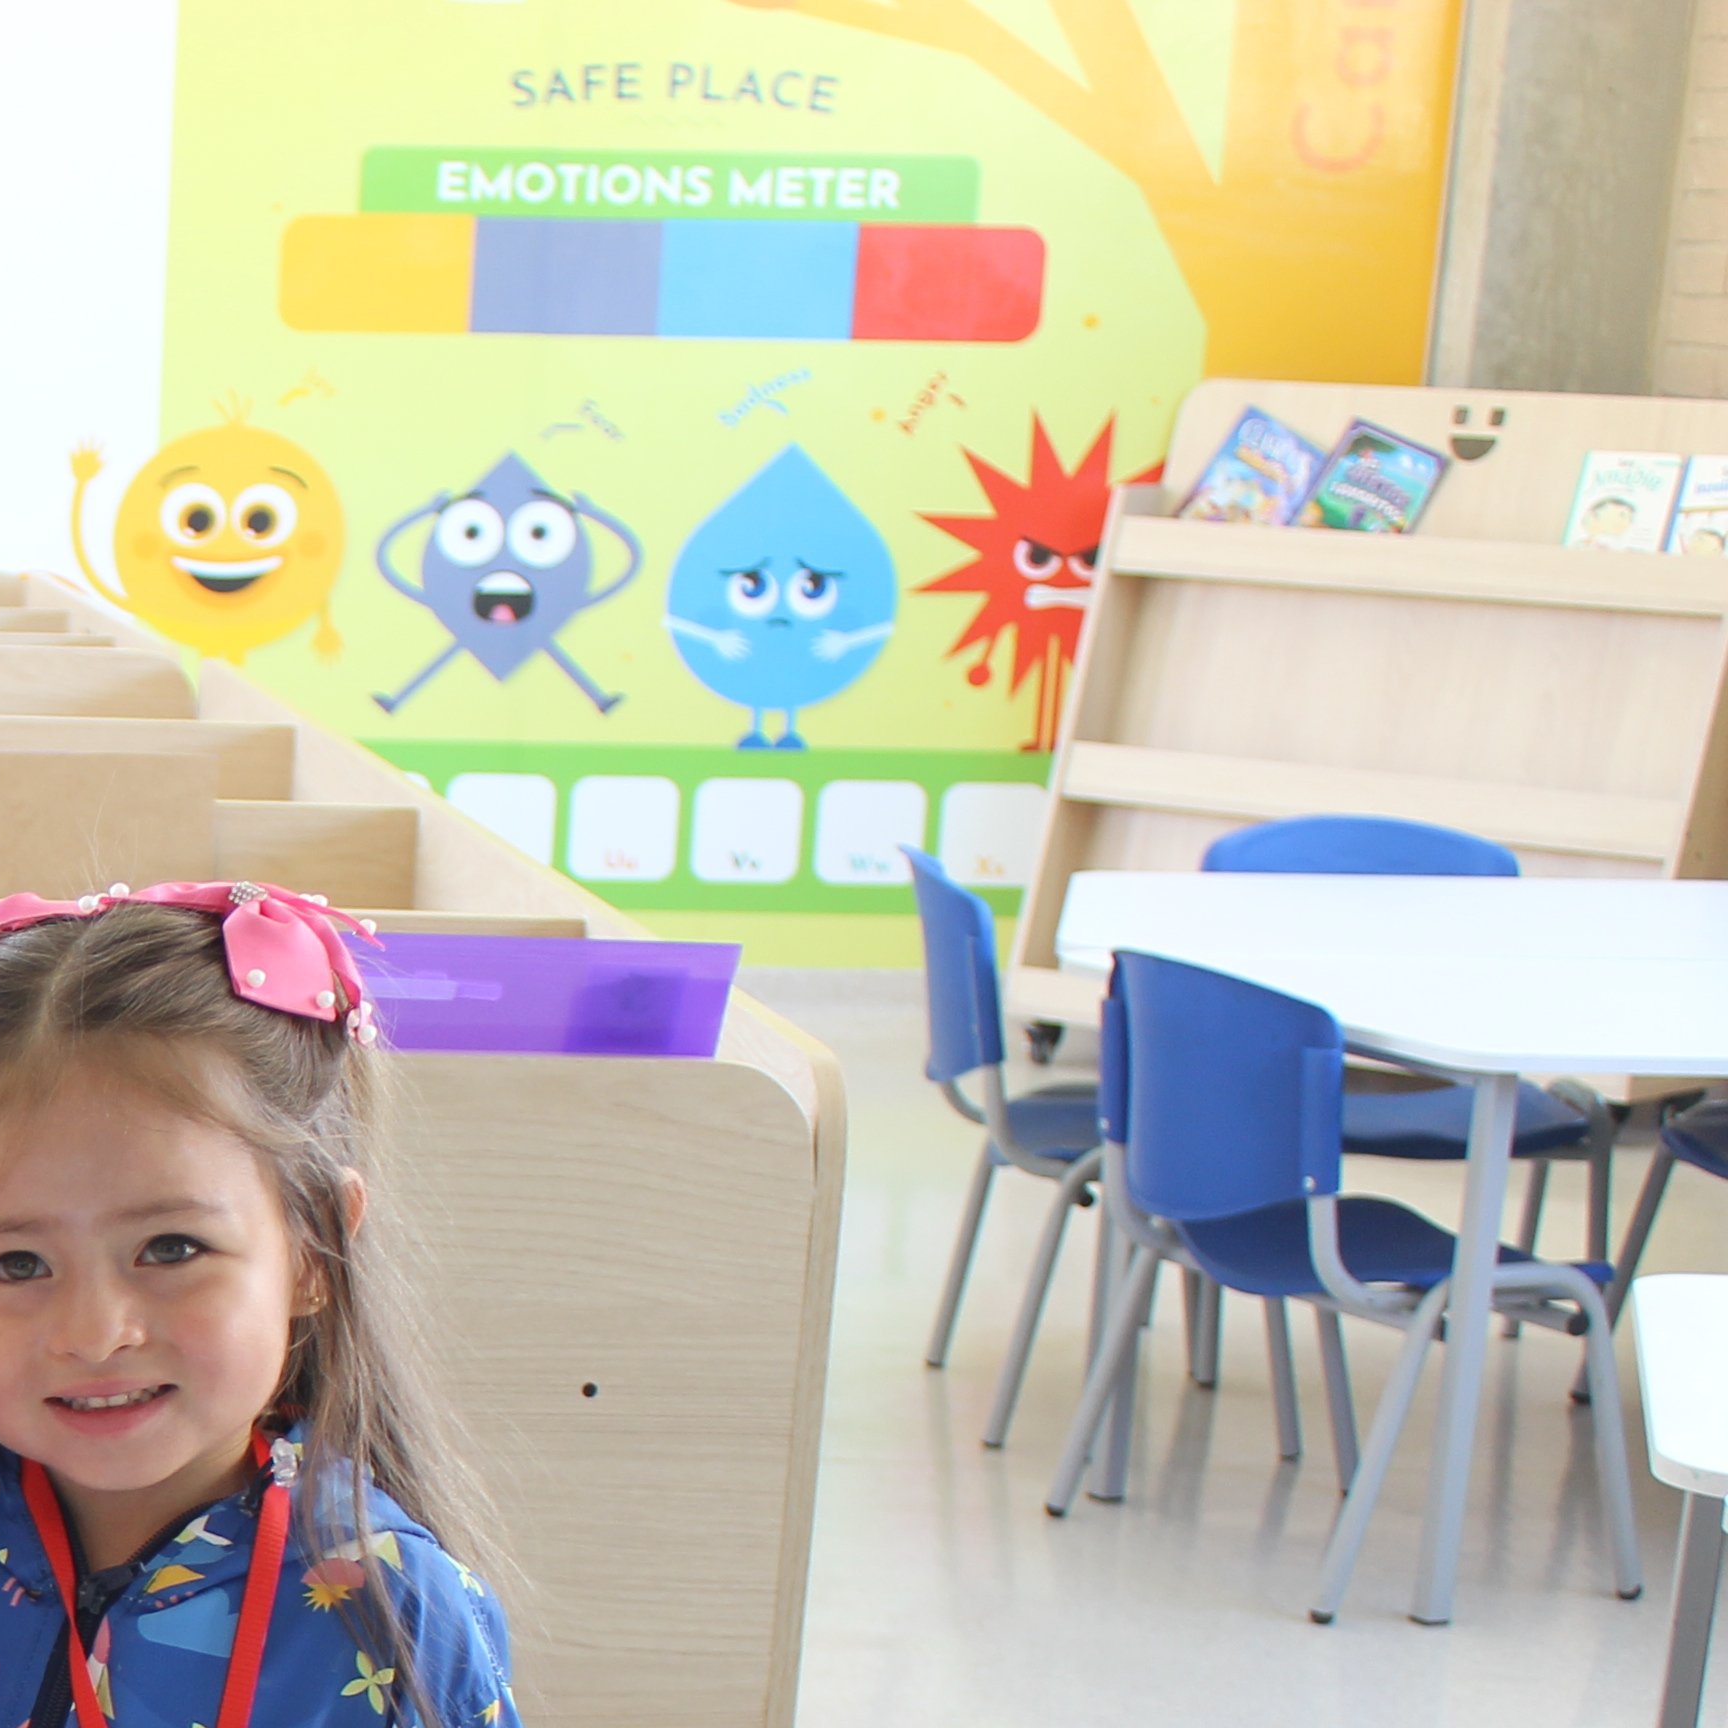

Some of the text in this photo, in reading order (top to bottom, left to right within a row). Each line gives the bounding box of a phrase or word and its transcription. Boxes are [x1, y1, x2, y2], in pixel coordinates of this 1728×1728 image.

[509, 61, 840, 114] SAFE PLACE
[1290, 0, 1396, 175] Ca
[435, 160, 902, 209] EMOTIONS METER
